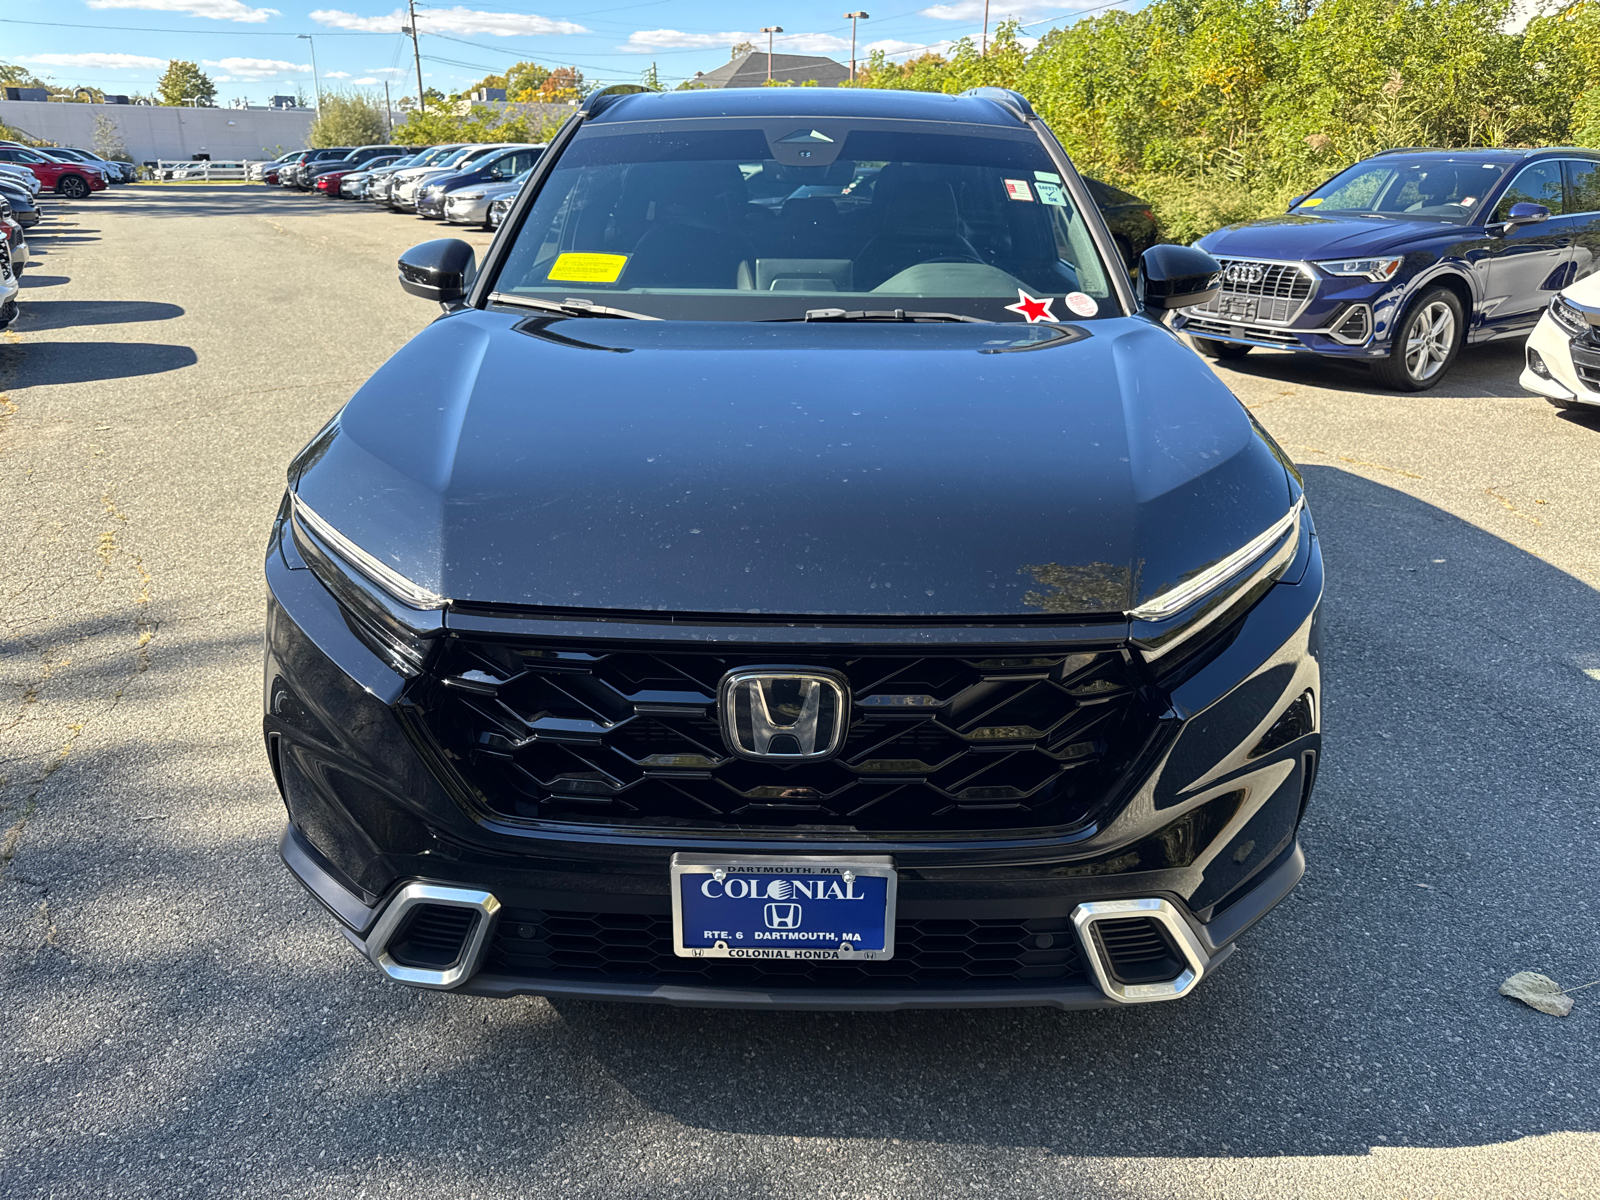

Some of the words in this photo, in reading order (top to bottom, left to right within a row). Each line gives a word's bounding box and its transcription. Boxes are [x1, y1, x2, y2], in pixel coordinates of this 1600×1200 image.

[701, 878, 865, 900] COLONIAL
[703, 930, 732, 939] RTE.
[735, 931, 744, 940] 6
[754, 931, 839, 942] DARTMOUTH,
[842, 932, 862, 942] MA
[728, 949, 791, 958] COLONIAL
[794, 950, 840, 959] HONDA
